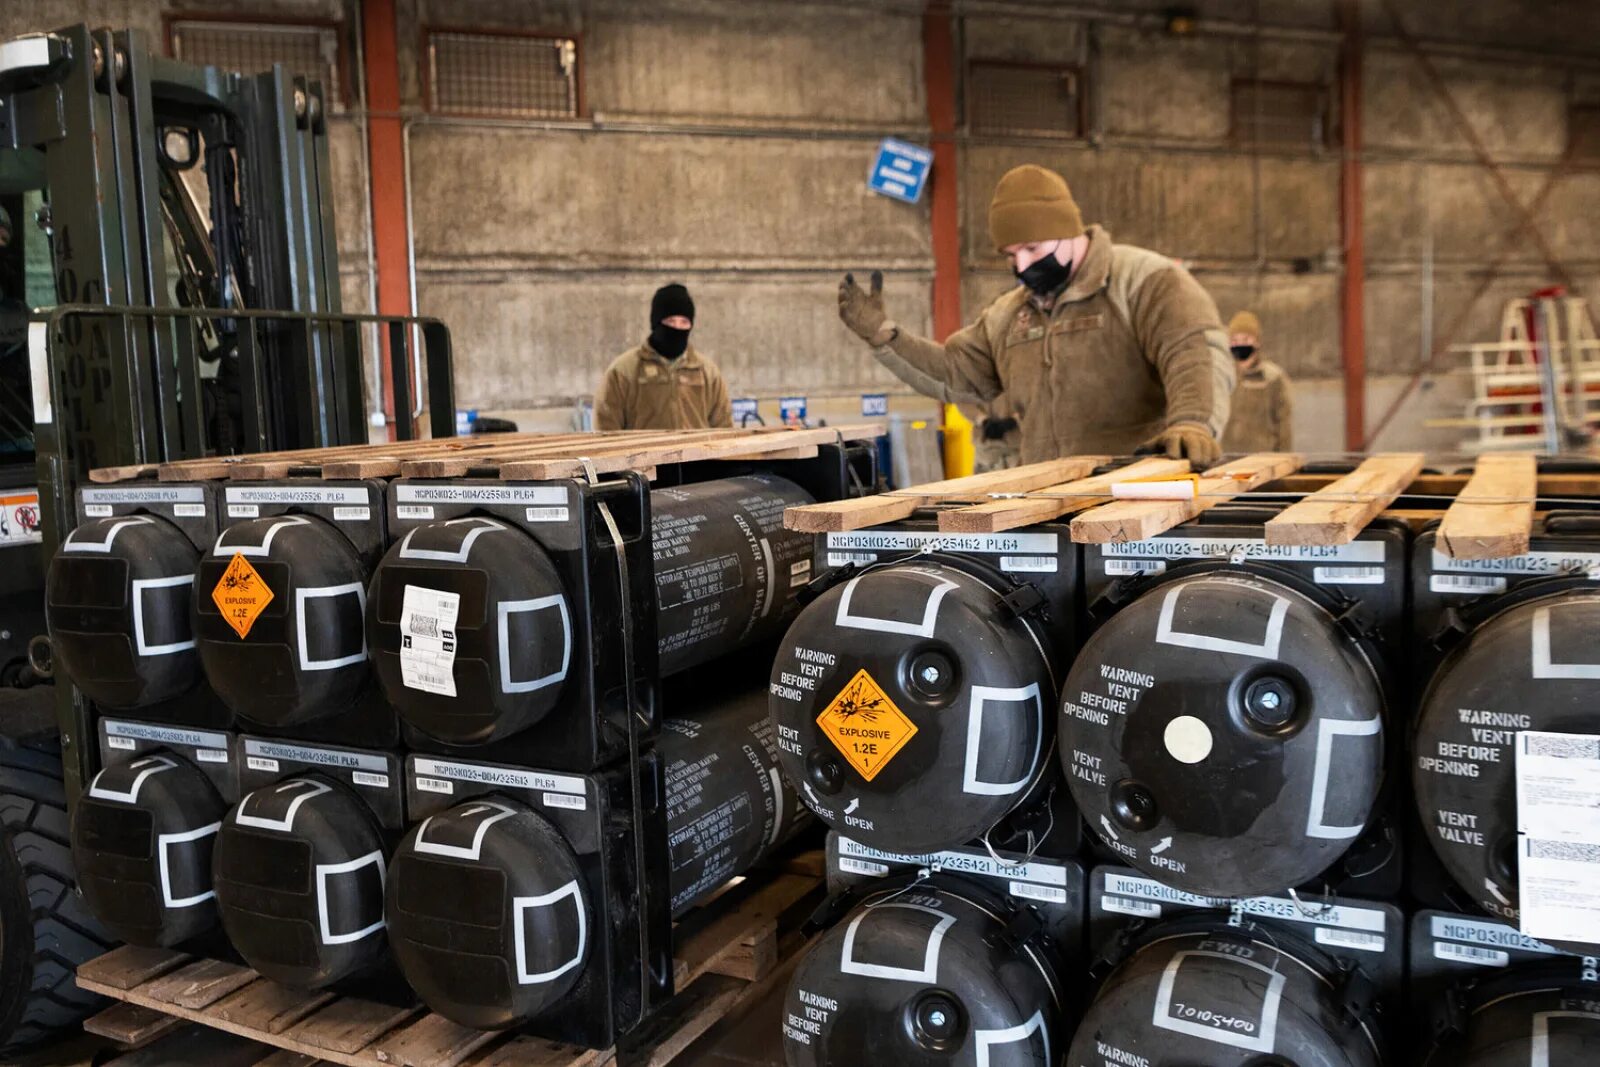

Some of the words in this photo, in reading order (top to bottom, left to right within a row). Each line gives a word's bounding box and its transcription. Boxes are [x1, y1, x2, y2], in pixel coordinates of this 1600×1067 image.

[513, 490, 535, 501] PL64
[733, 514, 763, 561] CENTER
[756, 565, 765, 584] OF
[986, 538, 1018, 551] PL64
[1299, 545, 1338, 558] PL64
[657, 571, 685, 587] STORAGE
[224, 597, 257, 605] EXPLOSIVE
[794, 646, 836, 666] WARNING
[800, 662, 825, 679] VENT
[1101, 664, 1155, 689] WARNING
[781, 672, 816, 692] BEFORE
[1108, 682, 1140, 702] VENT
[770, 682, 802, 703] OPENING
[1080, 691, 1128, 715] BEFORE
[1064, 702, 1109, 727] OPENING
[1458, 708, 1531, 729] WARNING
[778, 724, 800, 742] VENT
[839, 726, 891, 740] EXPLOSIVE
[1471, 727, 1516, 746] VENT
[777, 737, 803, 757] VALVE
[852, 743, 879, 756] 1.2E
[1438, 742, 1501, 763] BEFORE
[341, 756, 360, 768] PL64
[741, 744, 771, 793] CENTER
[863, 757, 870, 768] 1
[1073, 749, 1102, 770] VENT
[1418, 755, 1480, 778] OPENING
[534, 776, 556, 789] PL64
[1071, 763, 1107, 787] VALVE
[844, 815, 875, 831] OPEN
[1438, 810, 1479, 829] VENT
[1437, 825, 1486, 847] VALVE
[1098, 833, 1138, 859] CLOSE
[1150, 854, 1186, 874] OPEN
[1483, 901, 1521, 920] CLOS
[1197, 940, 1256, 959] FWD
[798, 989, 838, 1012] WARNING
[788, 1013, 821, 1036] BEFORE
[804, 1005, 829, 1024] VENT
[1096, 1041, 1152, 1067] WARNING
